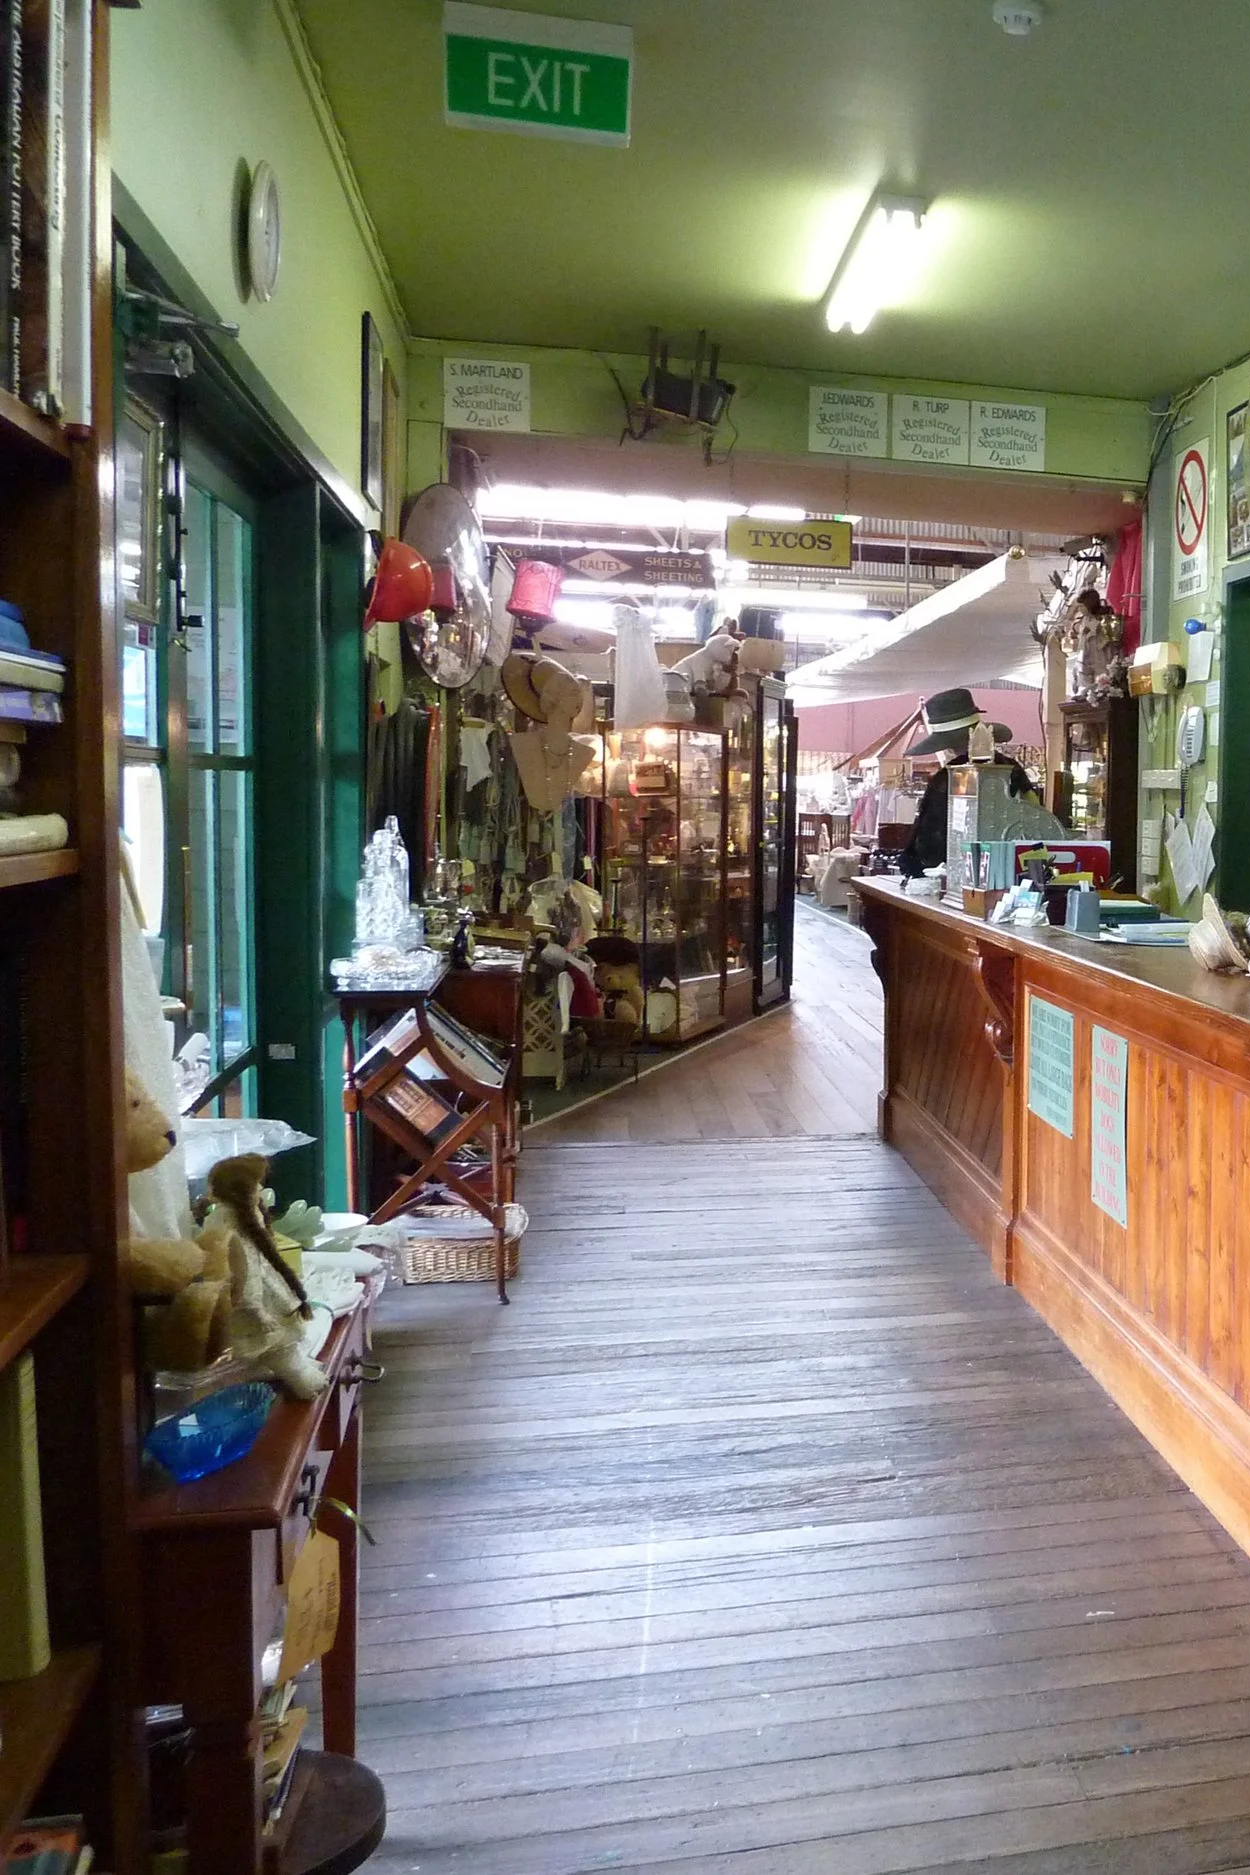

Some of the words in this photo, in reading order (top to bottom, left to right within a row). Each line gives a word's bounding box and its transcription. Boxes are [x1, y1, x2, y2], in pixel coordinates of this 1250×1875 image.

[487, 51, 591, 116] EXIT
[11, 235, 22, 290] BOOK
[461, 364, 524, 380] MARTLAND
[456, 384, 521, 402] Registered
[452, 396, 522, 412] Secondhand
[926, 401, 949, 414] TURP
[466, 410, 510, 427] Dealer
[819, 409, 877, 429] Registered
[992, 407, 1036, 422] EDWARDS
[816, 422, 880, 439] Secondhand
[903, 417, 960, 436] Registered
[981, 425, 1037, 443] Registered
[828, 437, 868, 453] Dealer
[900, 429, 961, 446] Secondhand
[977, 436, 1038, 452] Secondhand
[911, 443, 950, 460] Dealer
[989, 449, 1027, 466] Dealer
[748, 529, 833, 551] TYCOS
[579, 559, 621, 572] RALTEX
[644, 556, 692, 569] SHEETS
[644, 570, 705, 583] SHEETING
